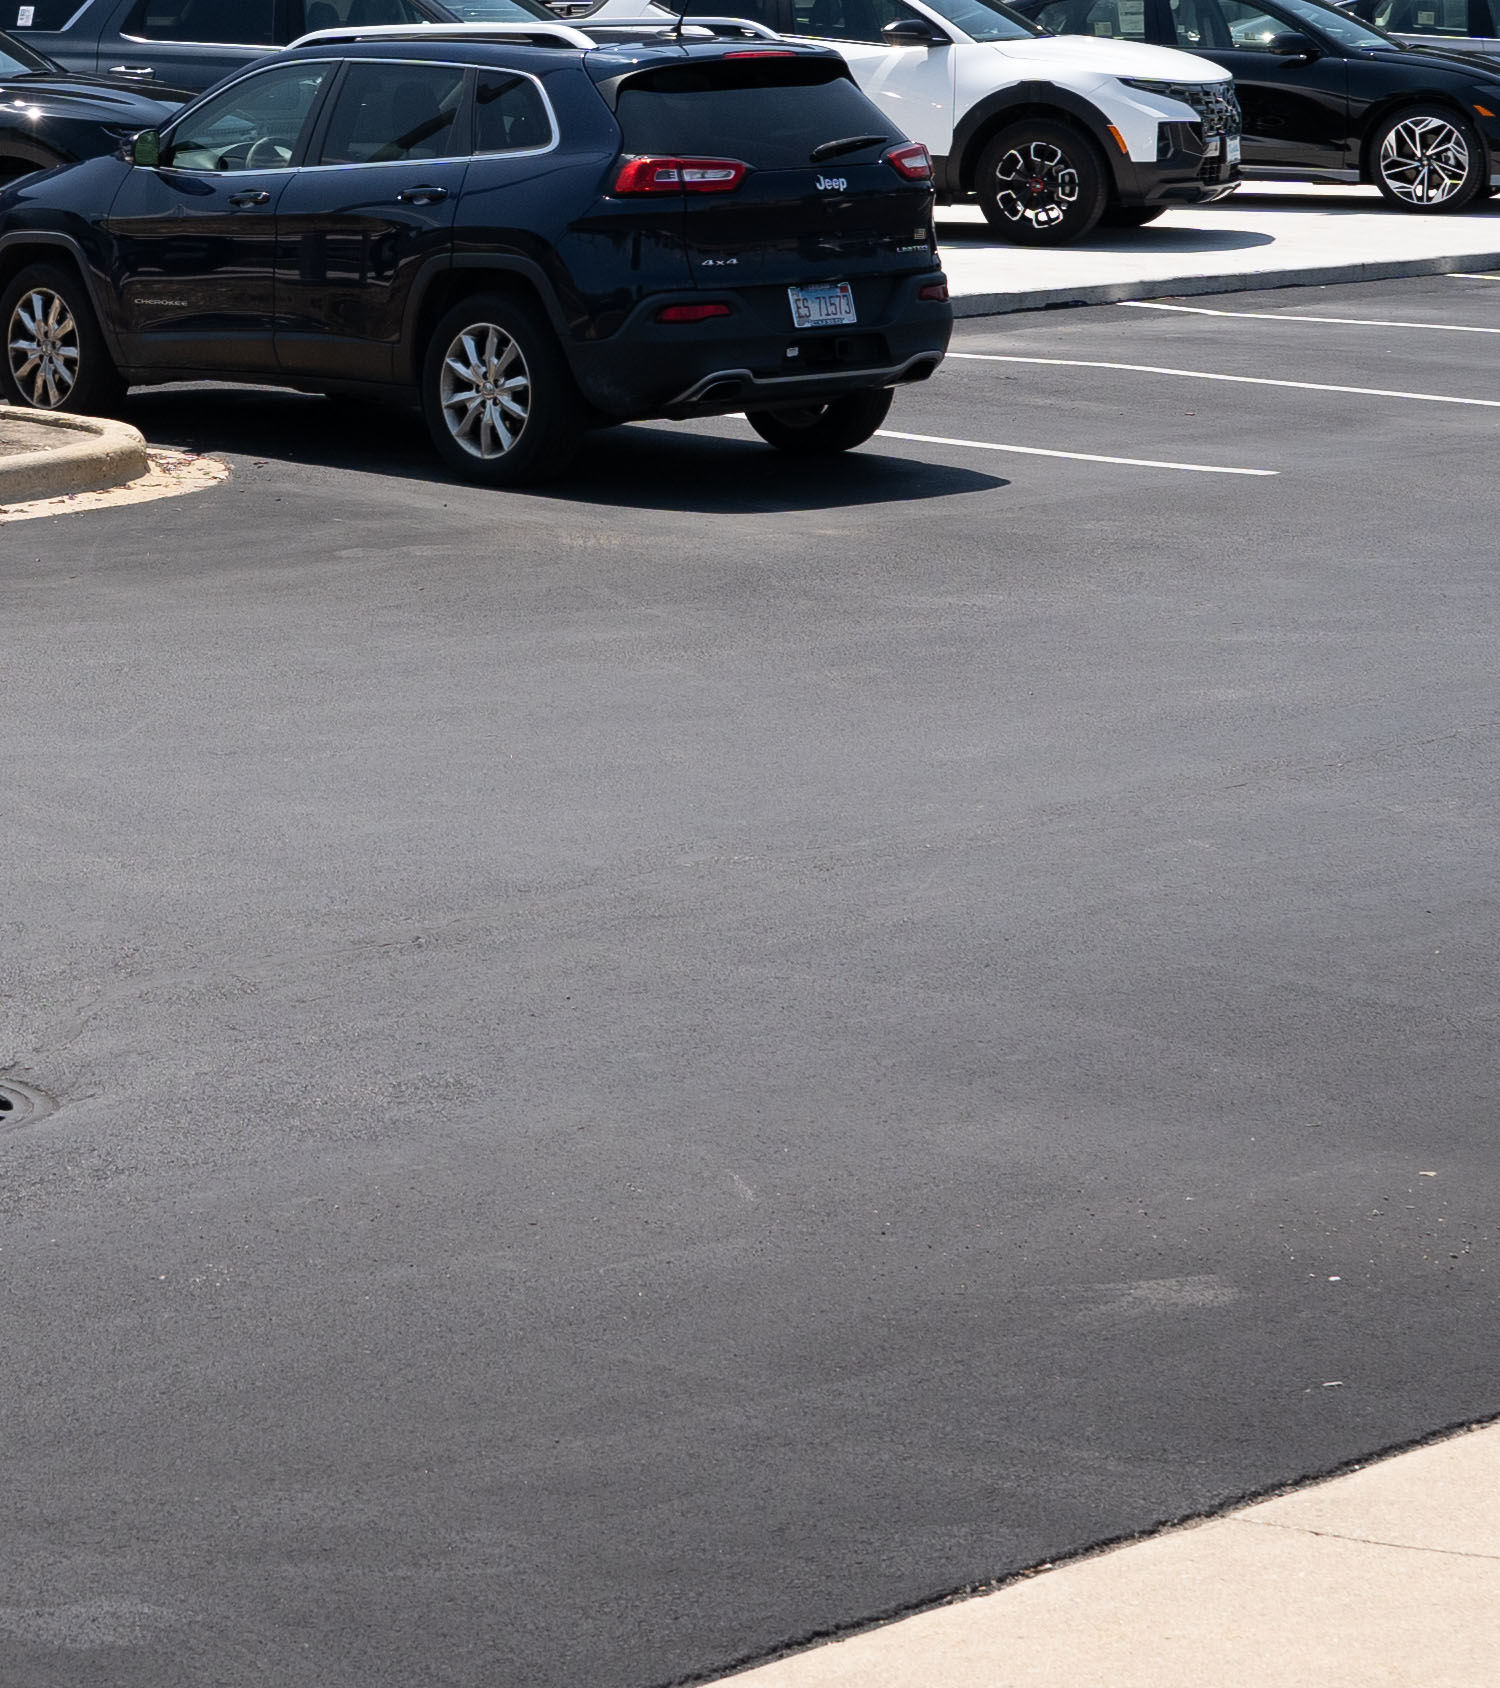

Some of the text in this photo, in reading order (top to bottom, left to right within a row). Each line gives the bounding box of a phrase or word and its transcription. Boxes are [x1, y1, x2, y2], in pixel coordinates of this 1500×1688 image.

[815, 174, 848, 192] Jeep
[701, 258, 738, 266] 4x4
[795, 294, 852, 318] ES 71573
